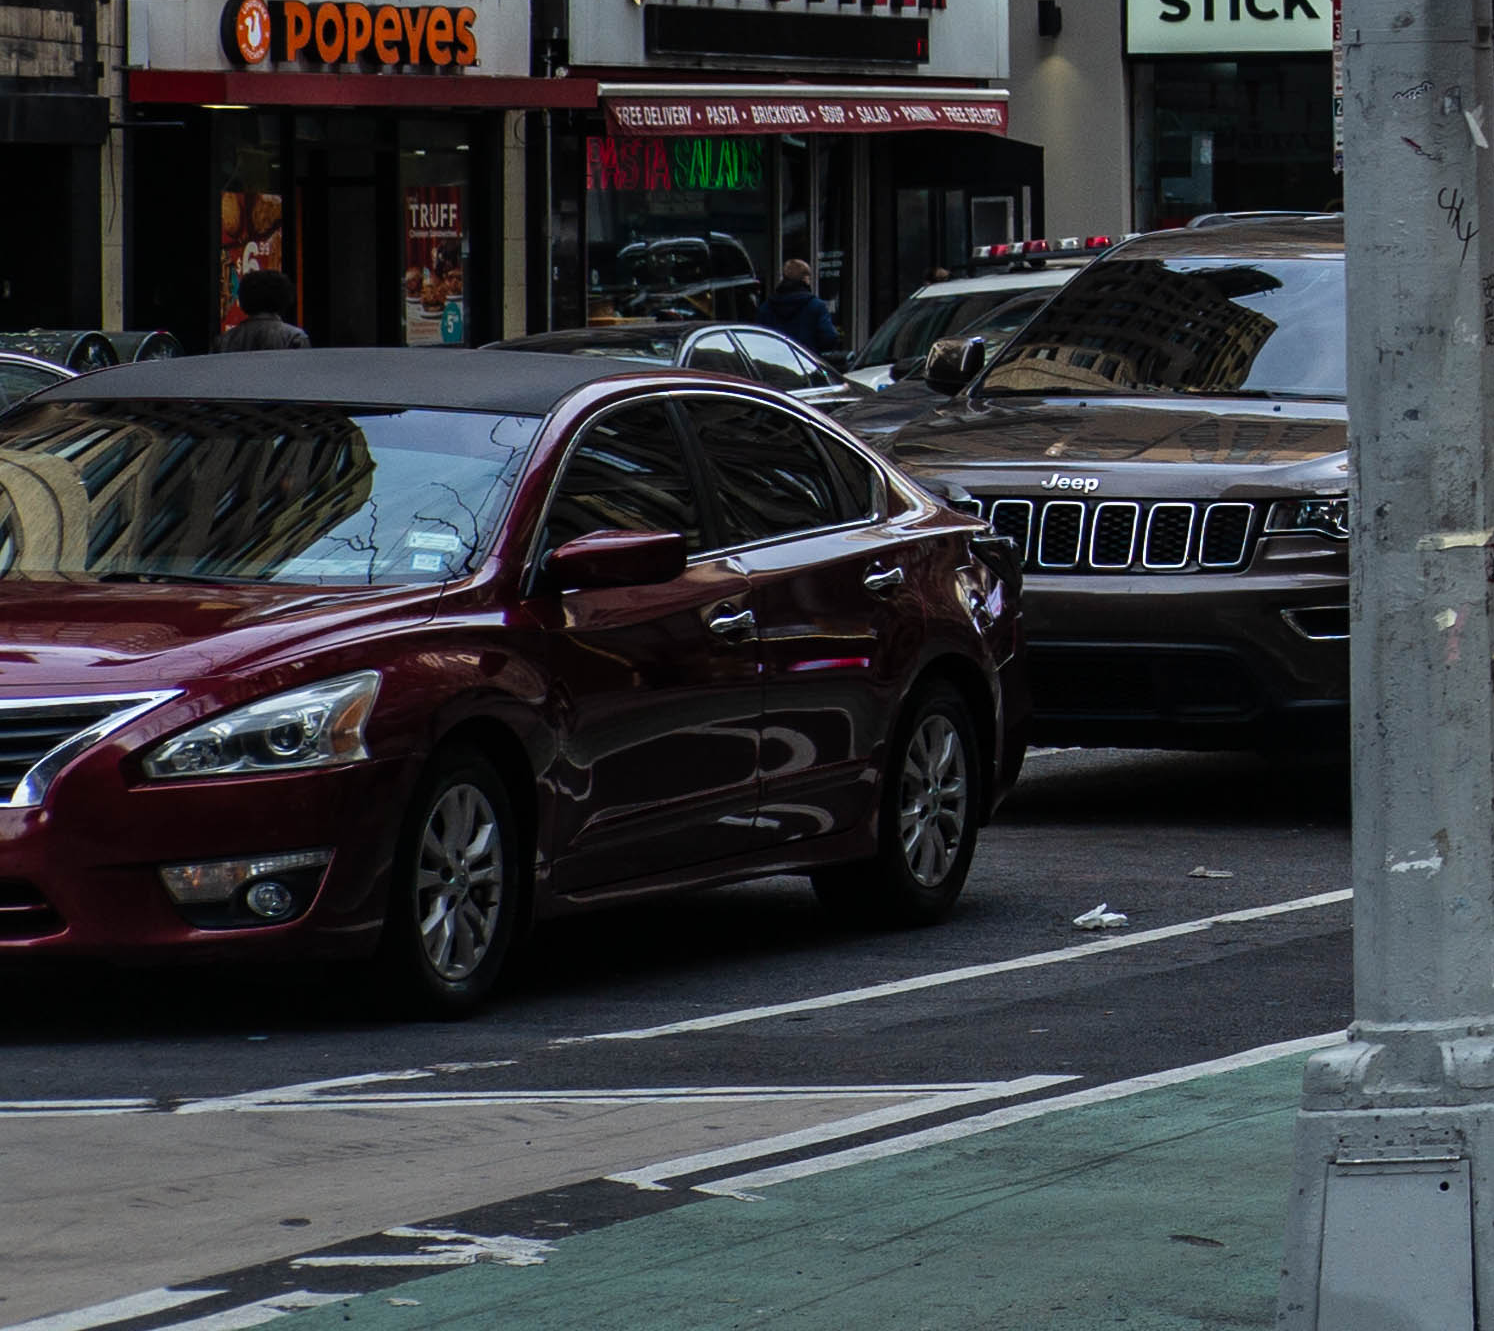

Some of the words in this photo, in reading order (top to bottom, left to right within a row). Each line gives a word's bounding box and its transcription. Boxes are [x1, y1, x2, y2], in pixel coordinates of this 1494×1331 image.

[616, 106, 645, 126] FREE
[645, 105, 692, 126] DELIVERY
[705, 106, 740, 125] PASTA
[751, 105, 810, 125] BRICKOVEN
[818, 106, 845, 124] SOUP
[856, 106, 891, 124] SALAD
[901, 106, 937, 123] PANINI
[942, 106, 967, 123] FREE
[409, 203, 458, 229] TRUFF
[1041, 474, 1100, 494] Jeep
